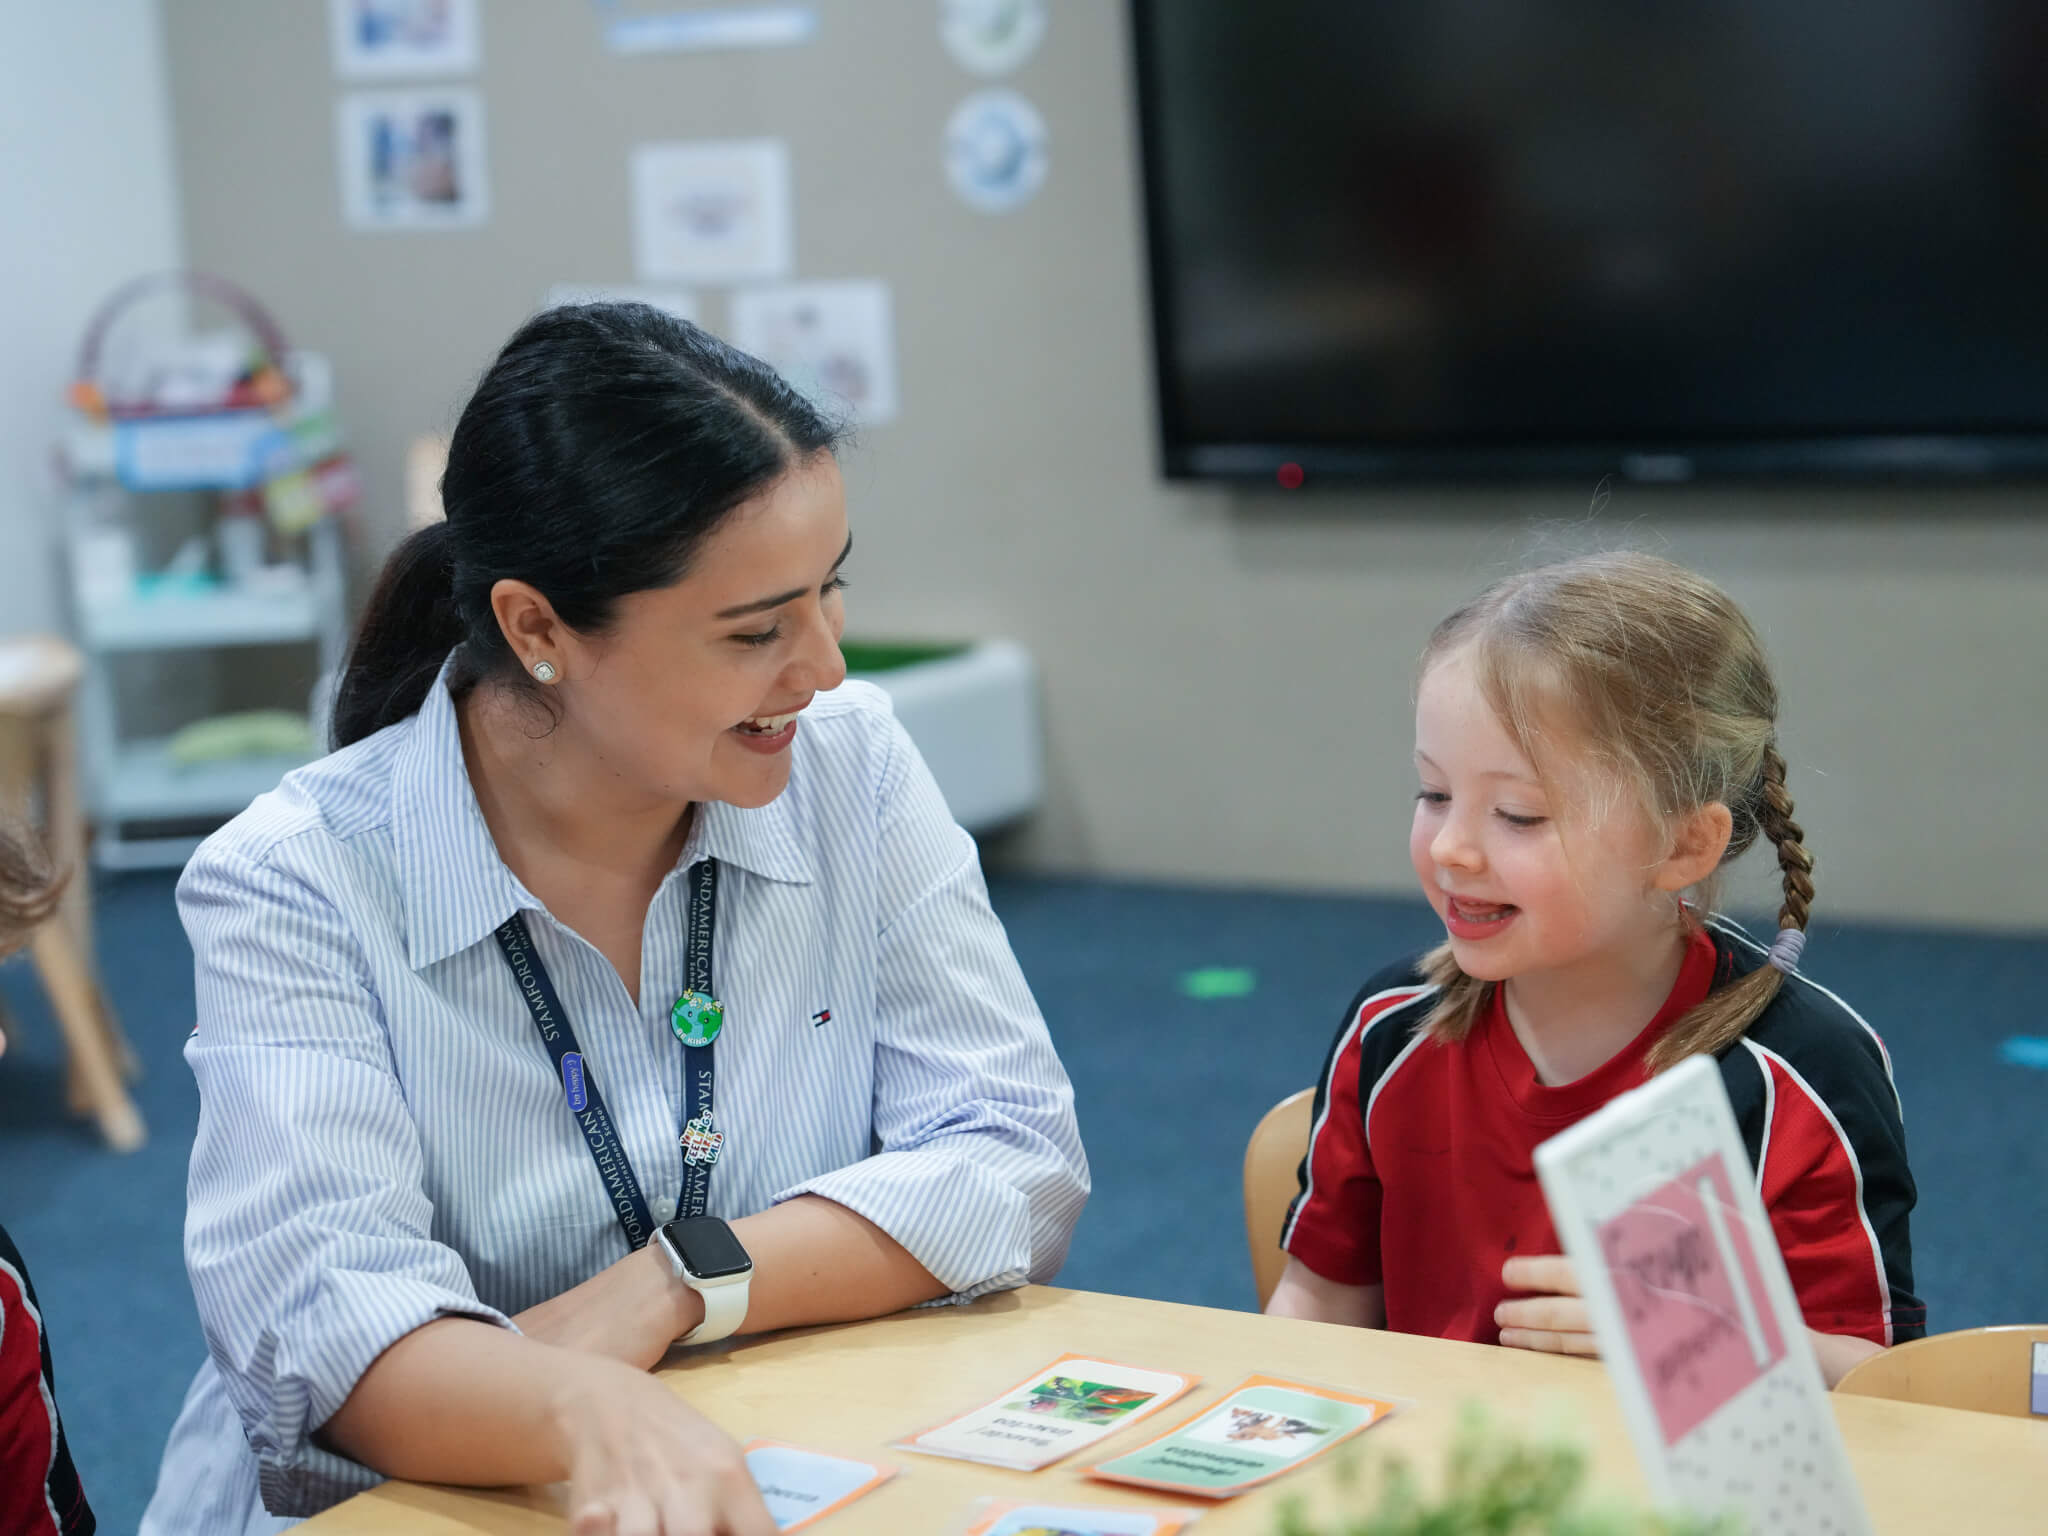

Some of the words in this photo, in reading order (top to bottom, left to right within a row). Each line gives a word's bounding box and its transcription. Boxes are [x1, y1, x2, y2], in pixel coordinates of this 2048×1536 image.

[697, 860, 714, 992] ORDAMERICAN
[595, 1105, 612, 1137] School
[681, 1120, 698, 1146] YOUR
[686, 1111, 712, 1165] FEELINGS
[700, 1134, 714, 1156] ARE
[706, 1133, 723, 1161] VALID
[612, 1140, 637, 1197] International
